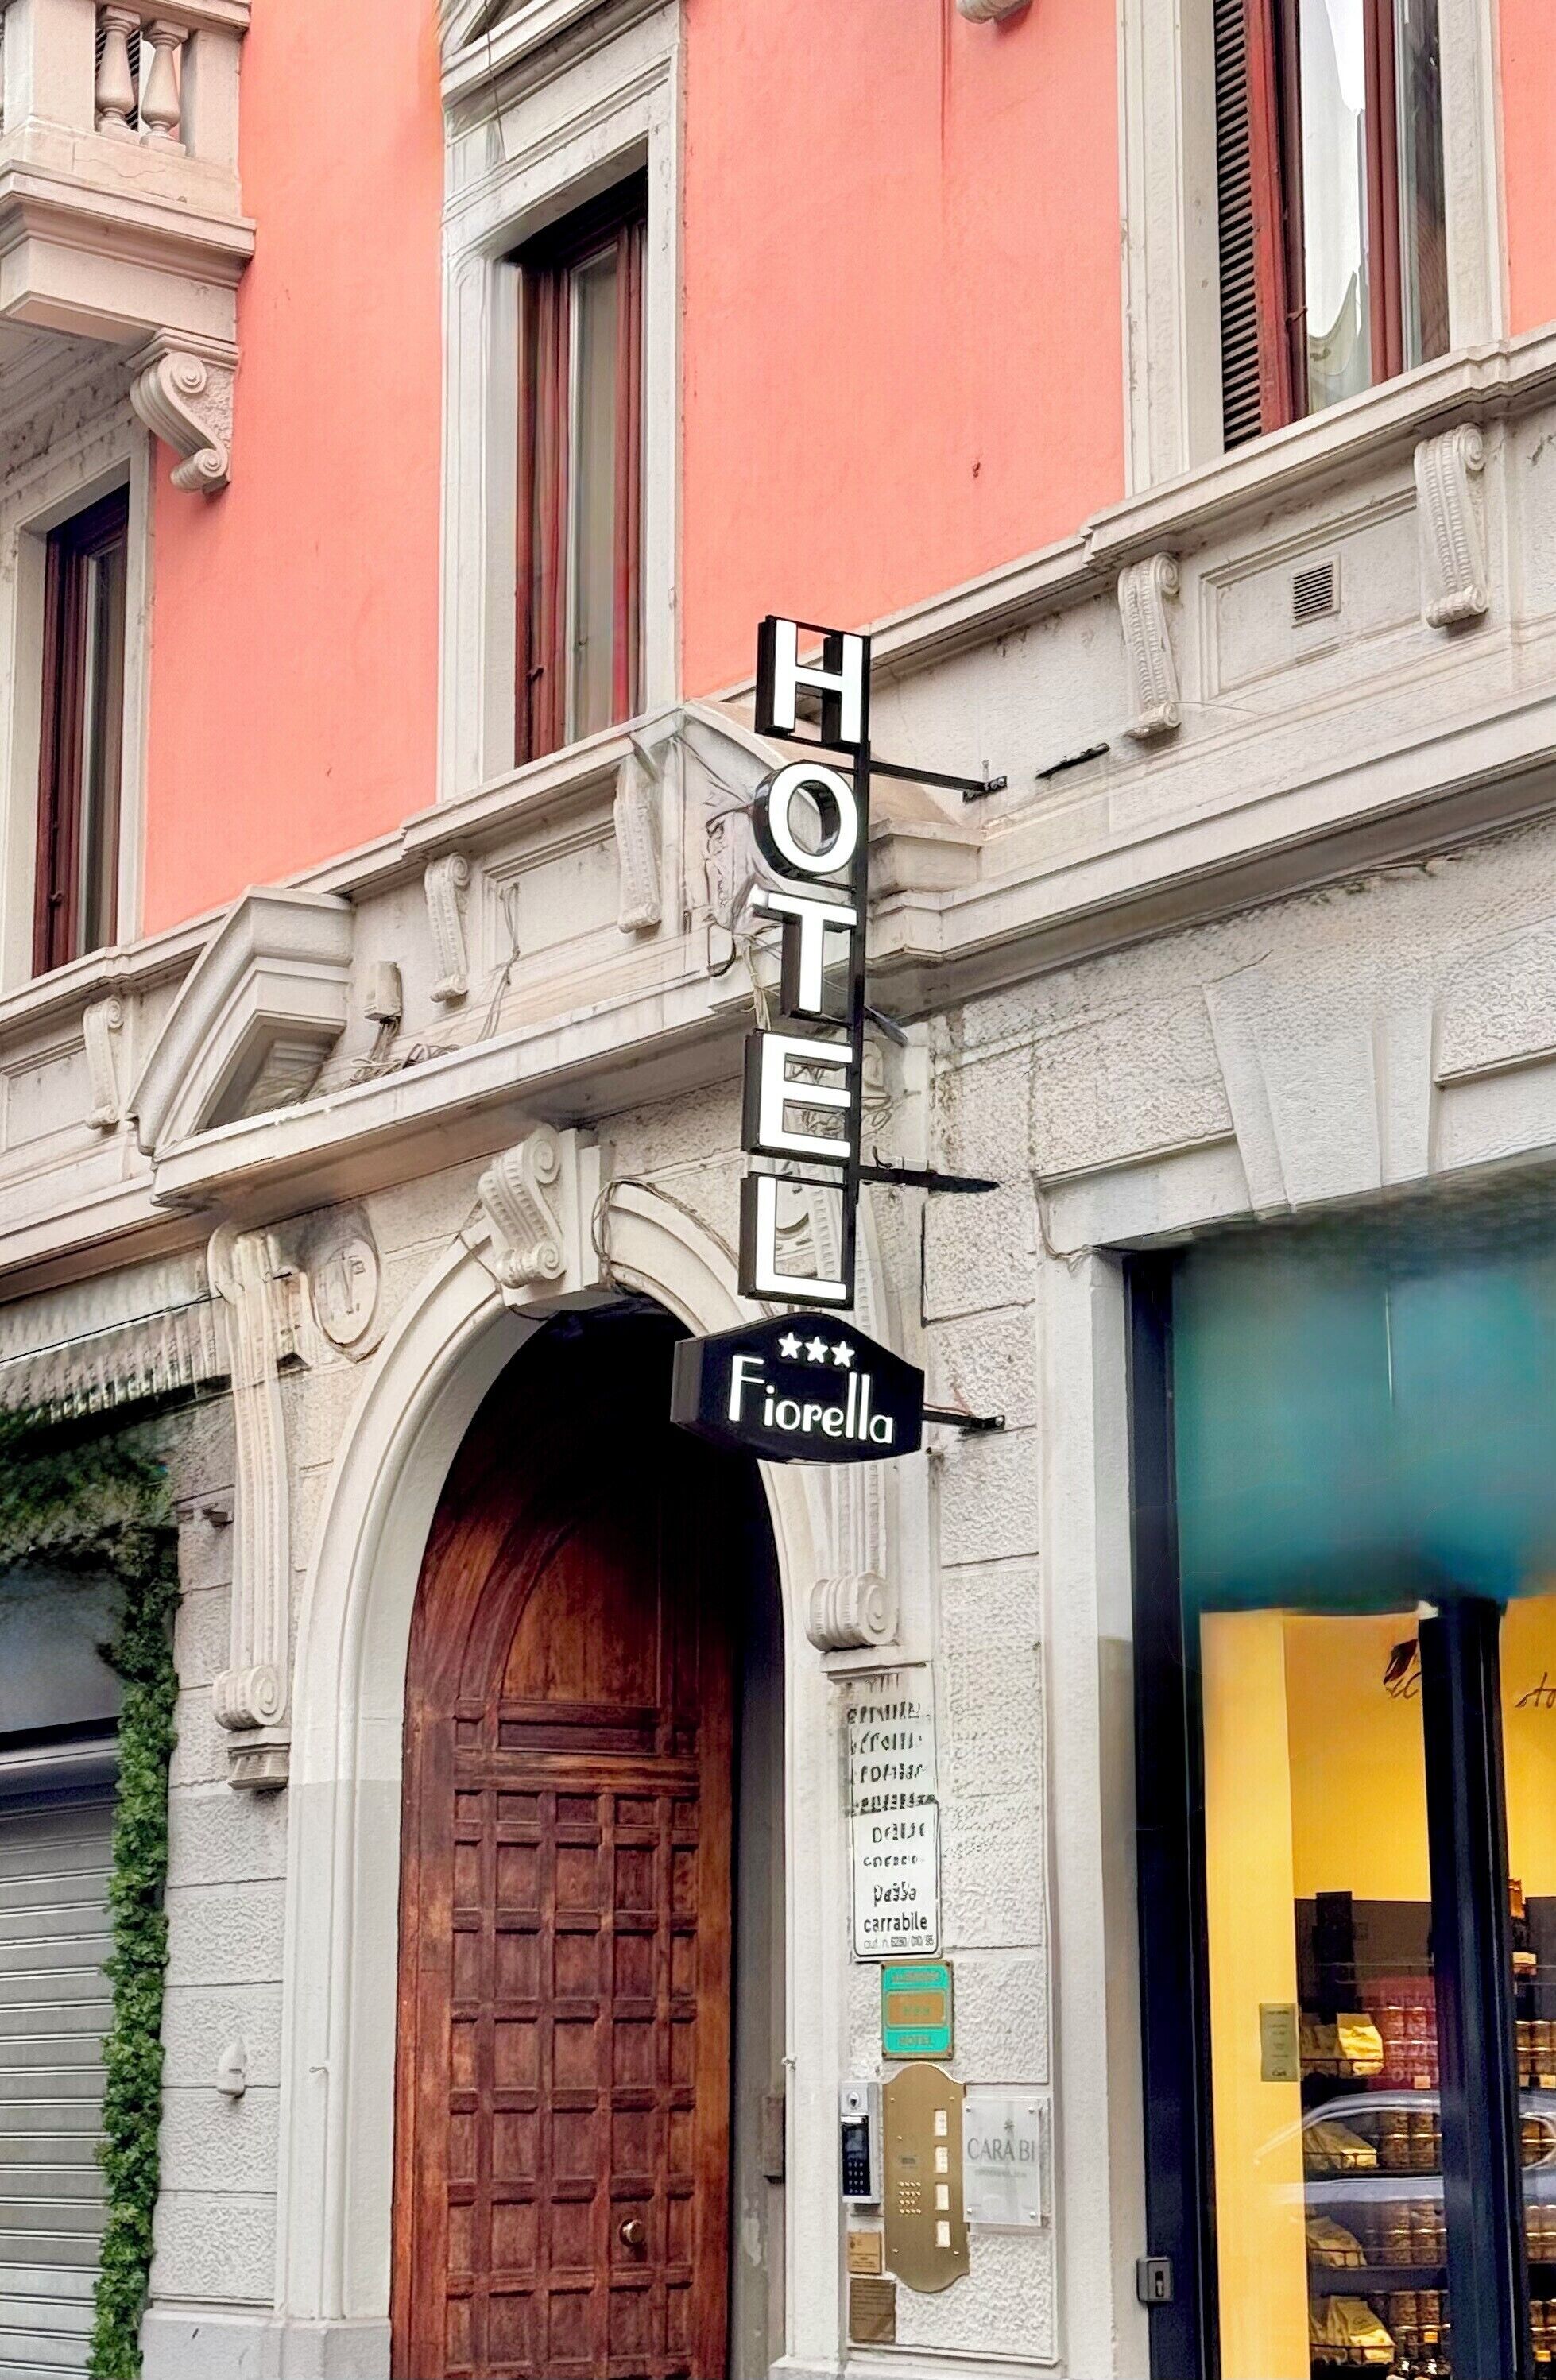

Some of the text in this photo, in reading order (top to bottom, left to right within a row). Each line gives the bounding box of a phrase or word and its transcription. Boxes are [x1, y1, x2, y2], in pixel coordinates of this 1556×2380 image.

[752, 619, 864, 1301] HOTEL
[728, 1354, 893, 1444] Fiorella
[864, 1911, 927, 1933] carrabile
